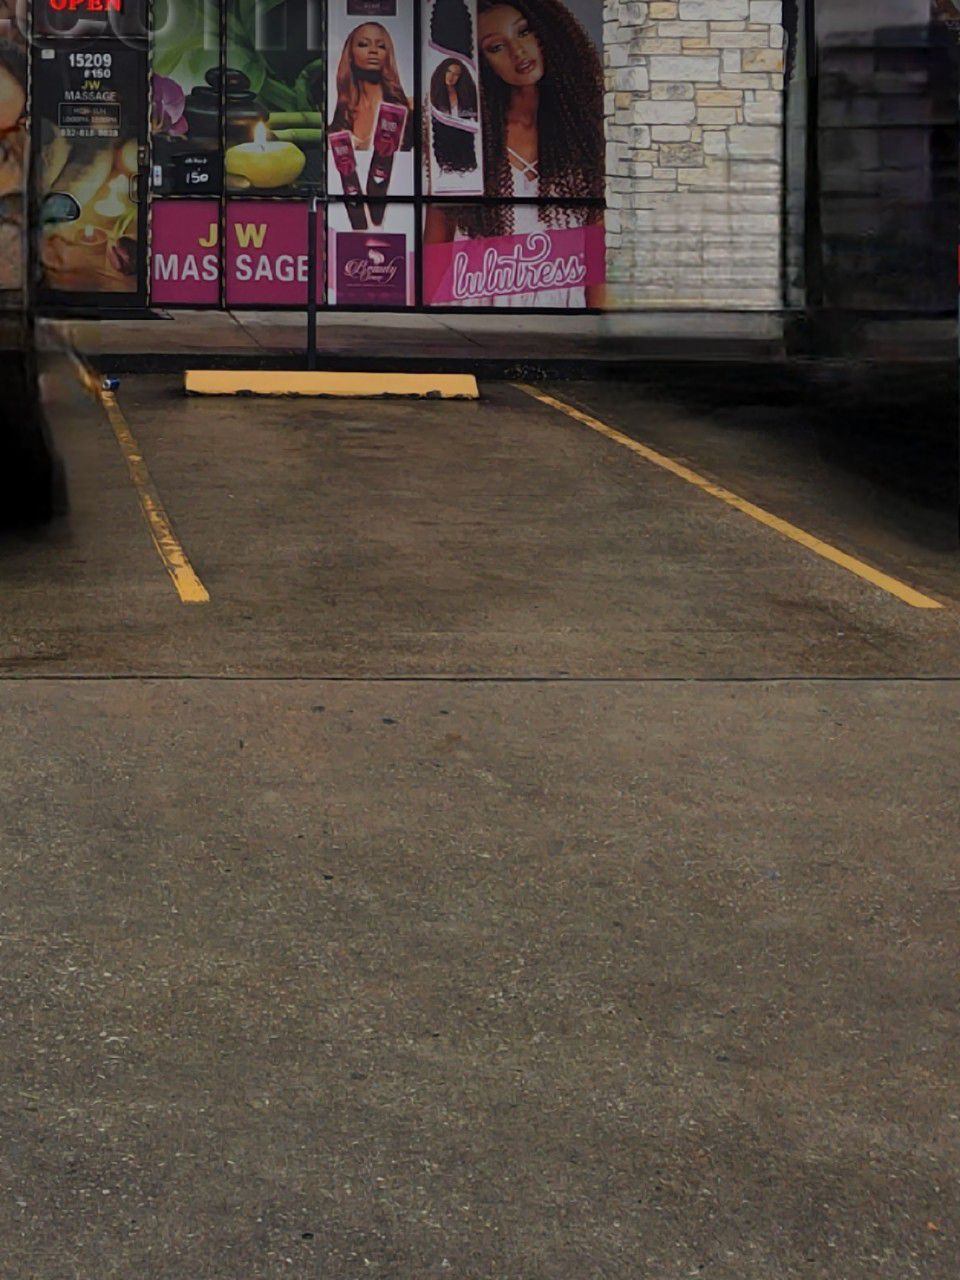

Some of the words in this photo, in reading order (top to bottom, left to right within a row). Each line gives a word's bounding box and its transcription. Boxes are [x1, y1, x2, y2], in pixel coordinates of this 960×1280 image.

[69, 53, 112, 67] 15209
[81, 80, 101, 90] JW
[64, 91, 117, 102] MASSAGE
[452, 231, 587, 300] lulutress
